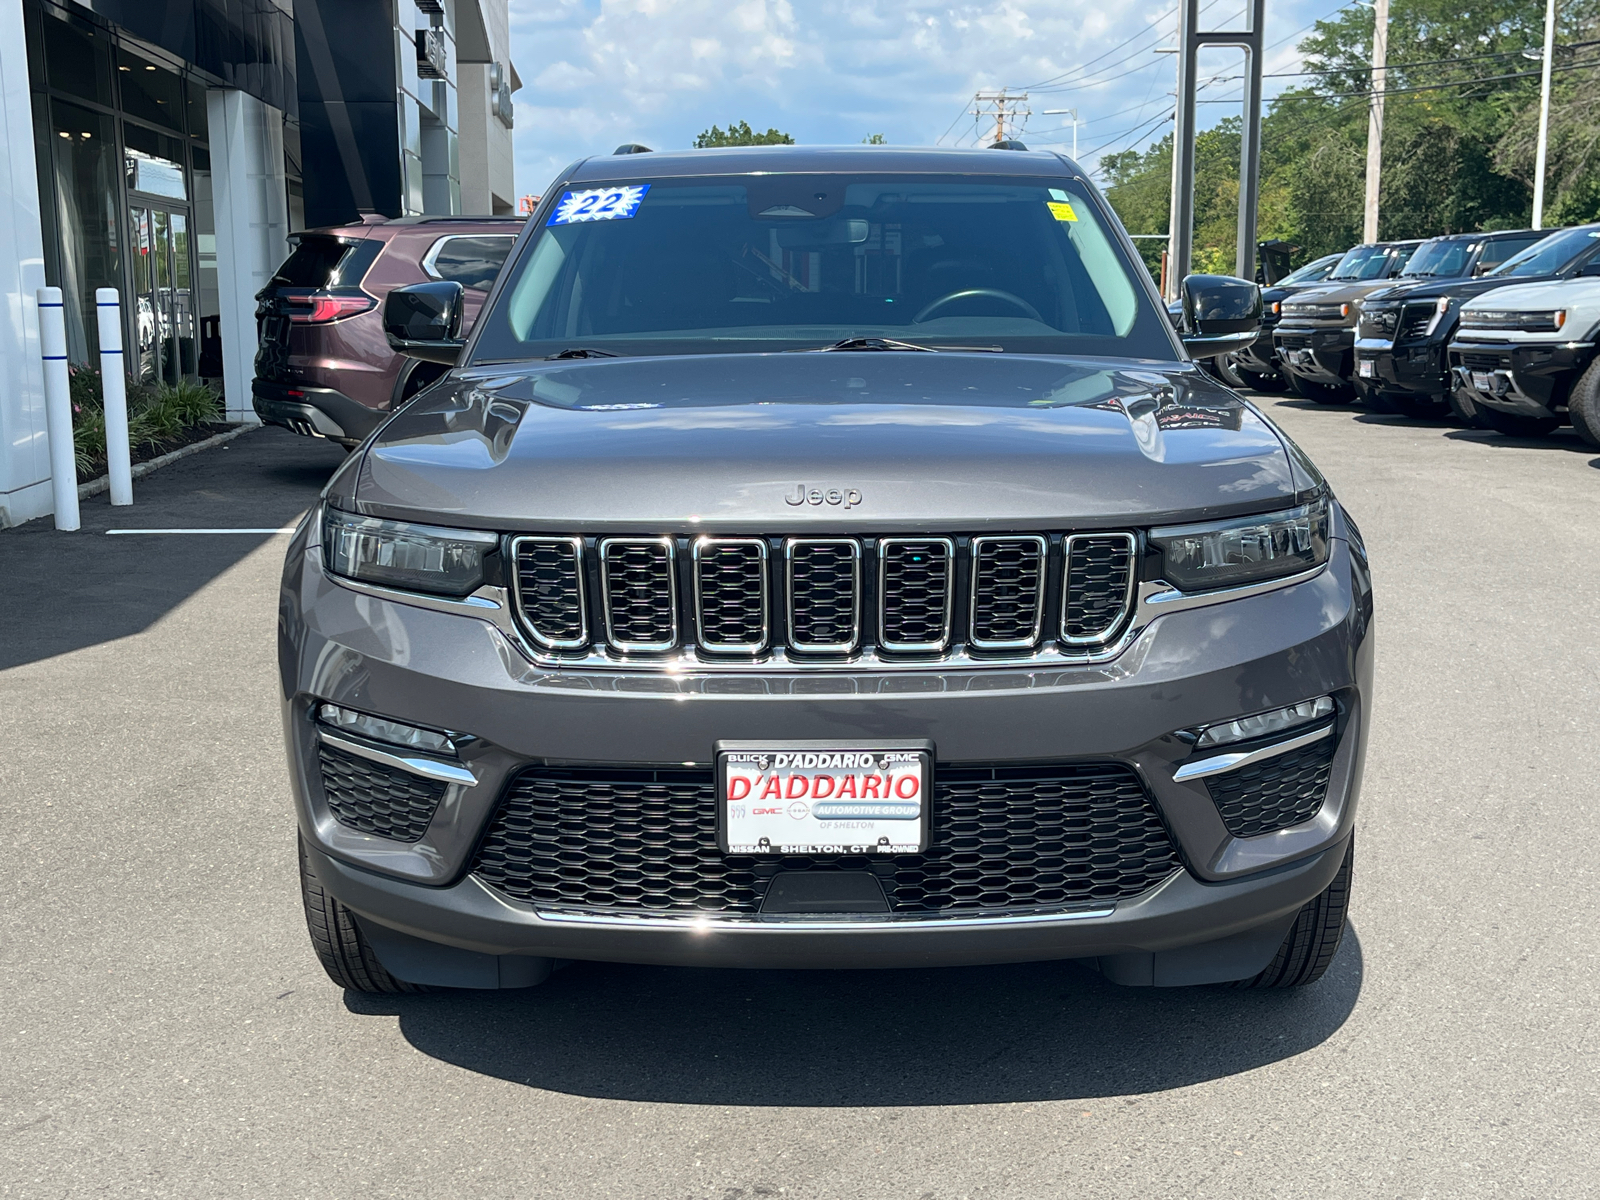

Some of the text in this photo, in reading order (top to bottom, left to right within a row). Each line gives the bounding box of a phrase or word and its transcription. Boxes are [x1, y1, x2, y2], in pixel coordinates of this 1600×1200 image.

[572, 193, 624, 216] 22
[785, 484, 863, 509] Jeep
[728, 753, 920, 769] BUICK D'ADDARIO GMC
[727, 774, 920, 800] D'ADDARIO
[752, 807, 783, 815] GMC
[817, 806, 917, 815] AUTOMOTIVE GROUP
[819, 821, 875, 829] OF SHELTON
[728, 845, 770, 853] NISSAN
[780, 845, 848, 854] SHELTON,
[850, 845, 870, 853] CT
